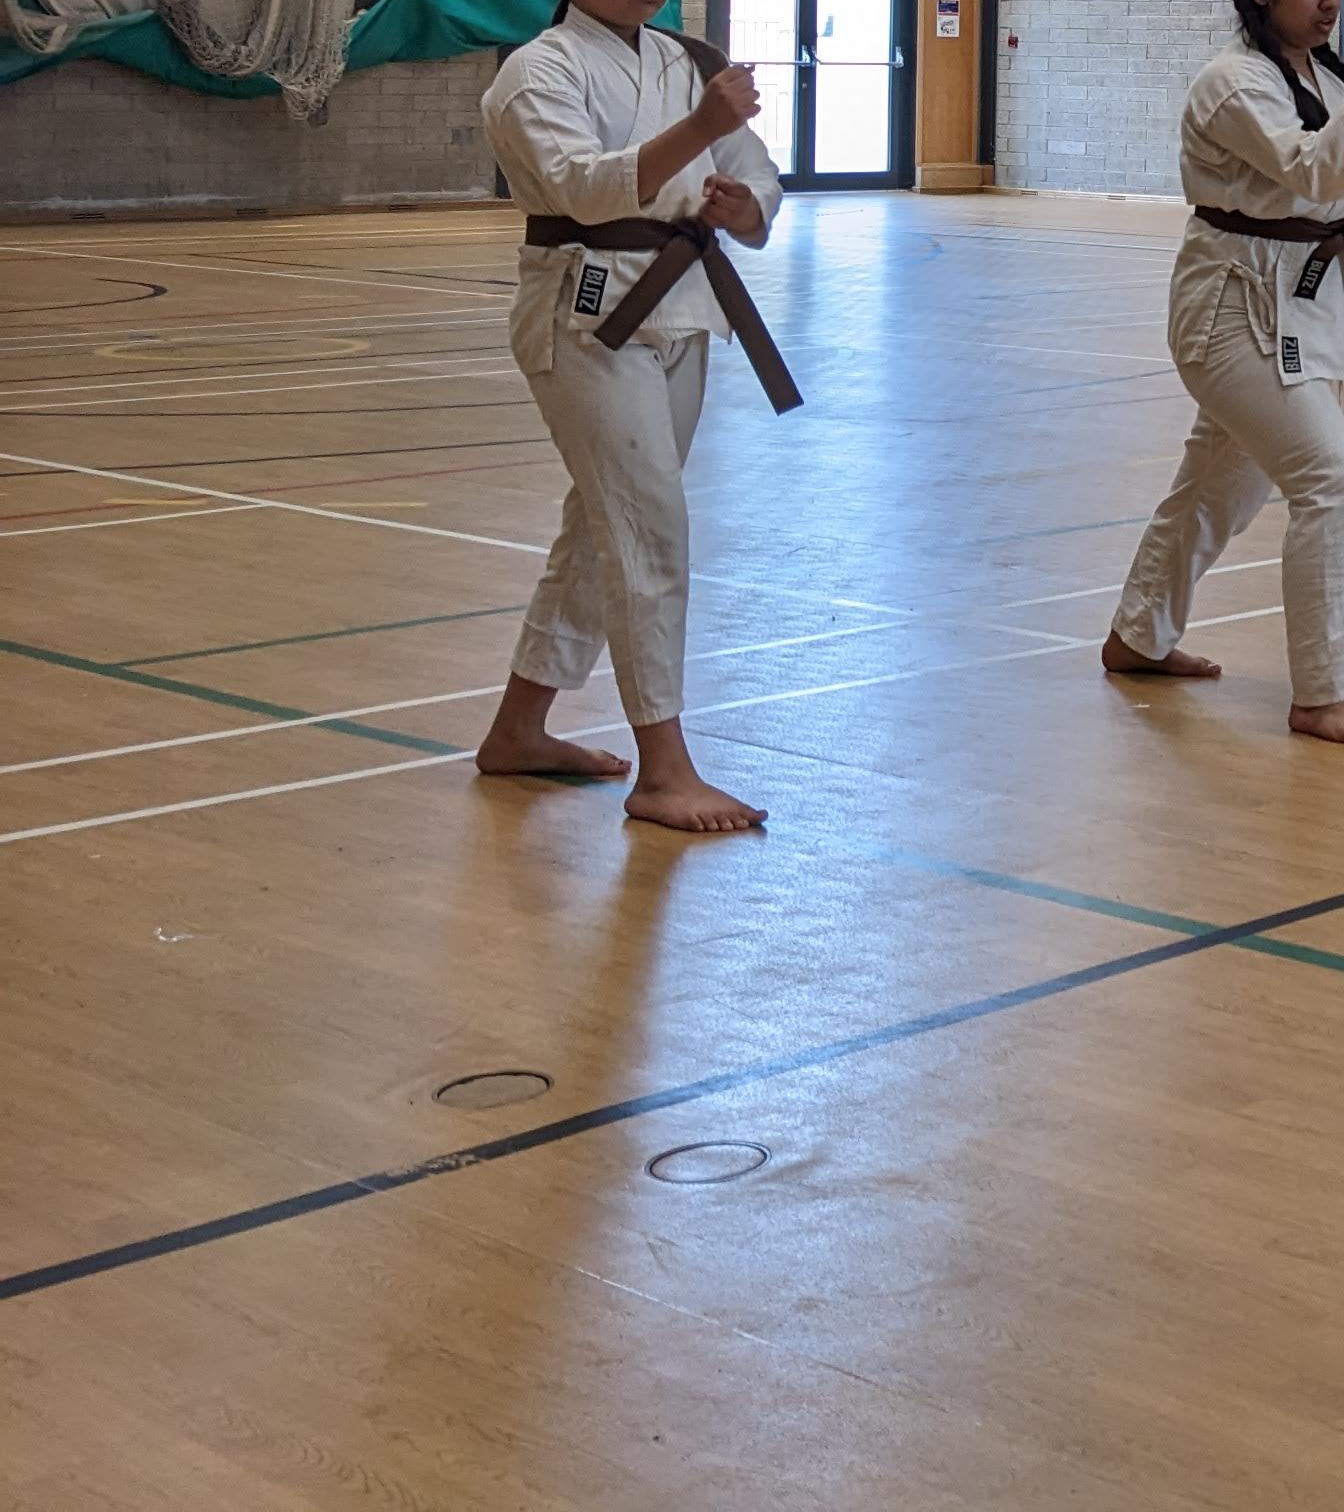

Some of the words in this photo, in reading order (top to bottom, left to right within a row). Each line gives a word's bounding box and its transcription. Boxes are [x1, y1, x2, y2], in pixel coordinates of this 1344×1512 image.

[578, 268, 606, 311] BLITZ
[1302, 259, 1325, 289] BLITZ
[1284, 338, 1300, 371] BLITZ
